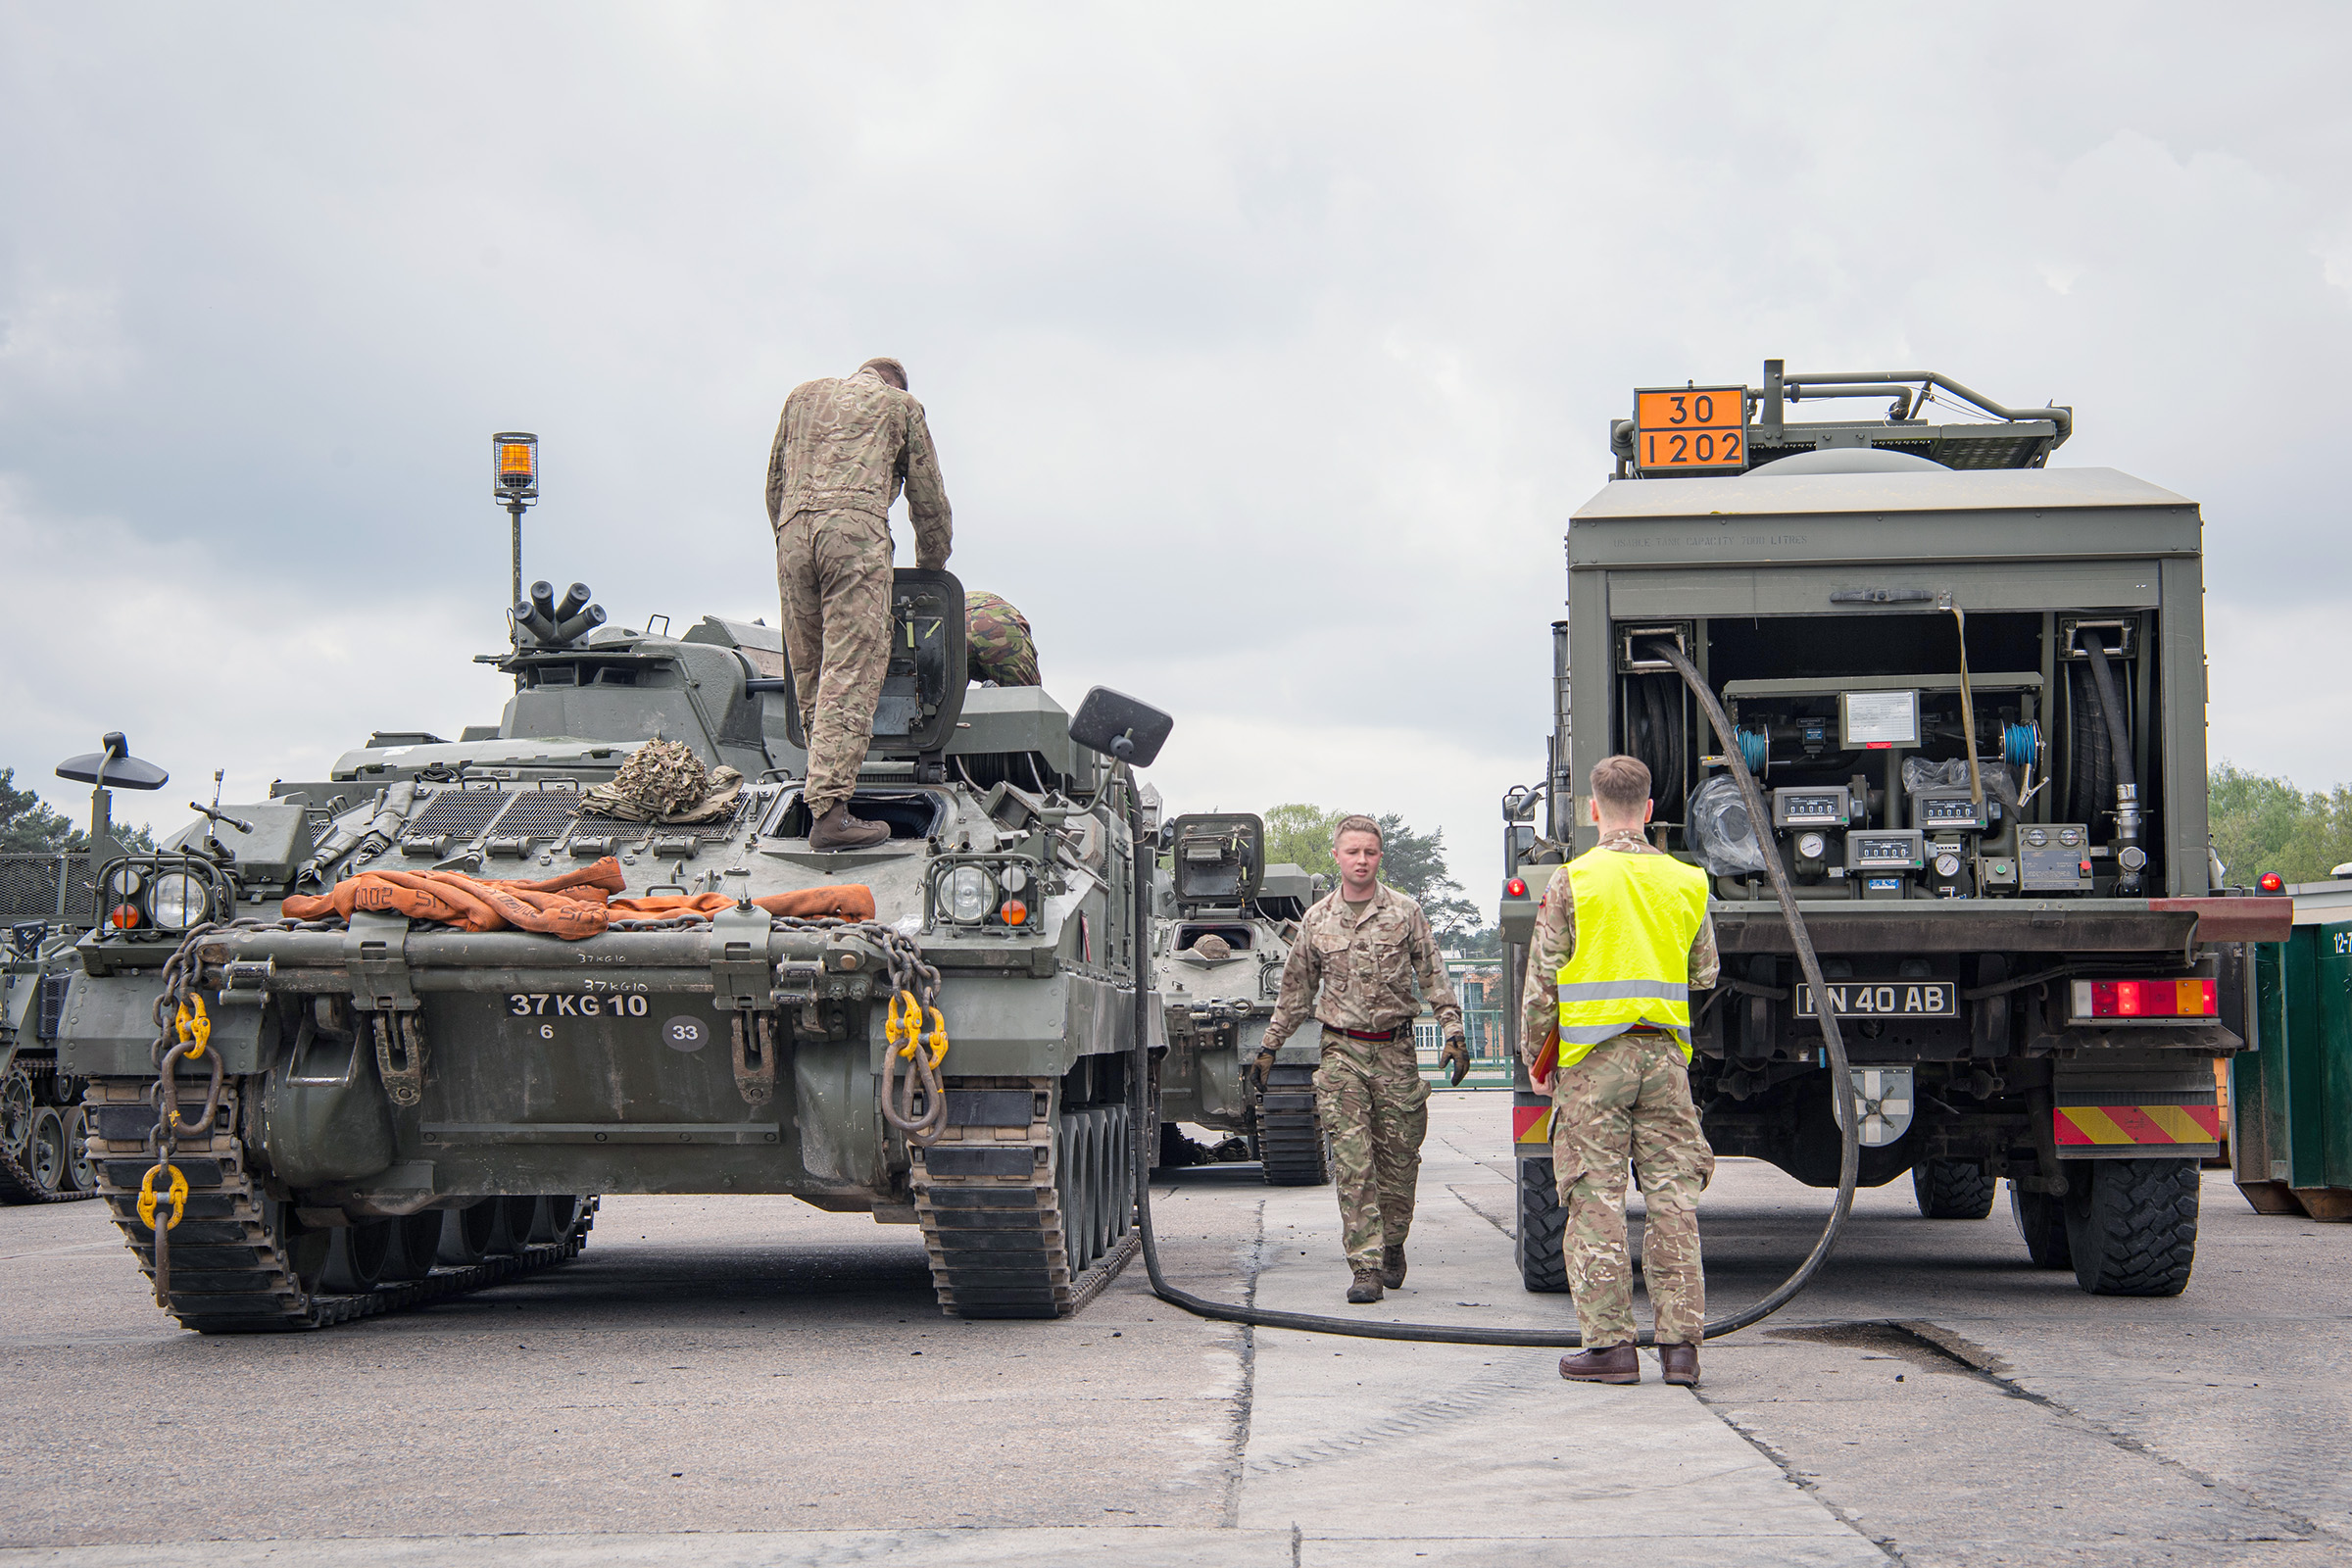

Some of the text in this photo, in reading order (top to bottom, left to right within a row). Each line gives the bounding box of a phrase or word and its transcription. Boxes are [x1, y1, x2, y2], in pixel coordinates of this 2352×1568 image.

[1669, 395, 1713, 424] 30
[1649, 433, 1740, 464] 1202
[1613, 538, 1651, 548] USABLE
[1656, 537, 1680, 547] TANK
[1686, 536, 1734, 546] CAPACITY
[1771, 535, 1808, 545] LITRES
[510, 994, 648, 1016] 37 KG 10
[1855, 987, 1895, 1012] 40
[1904, 986, 1944, 1012] AB
[540, 1024, 554, 1039] 6
[672, 1025, 699, 1040] 33
